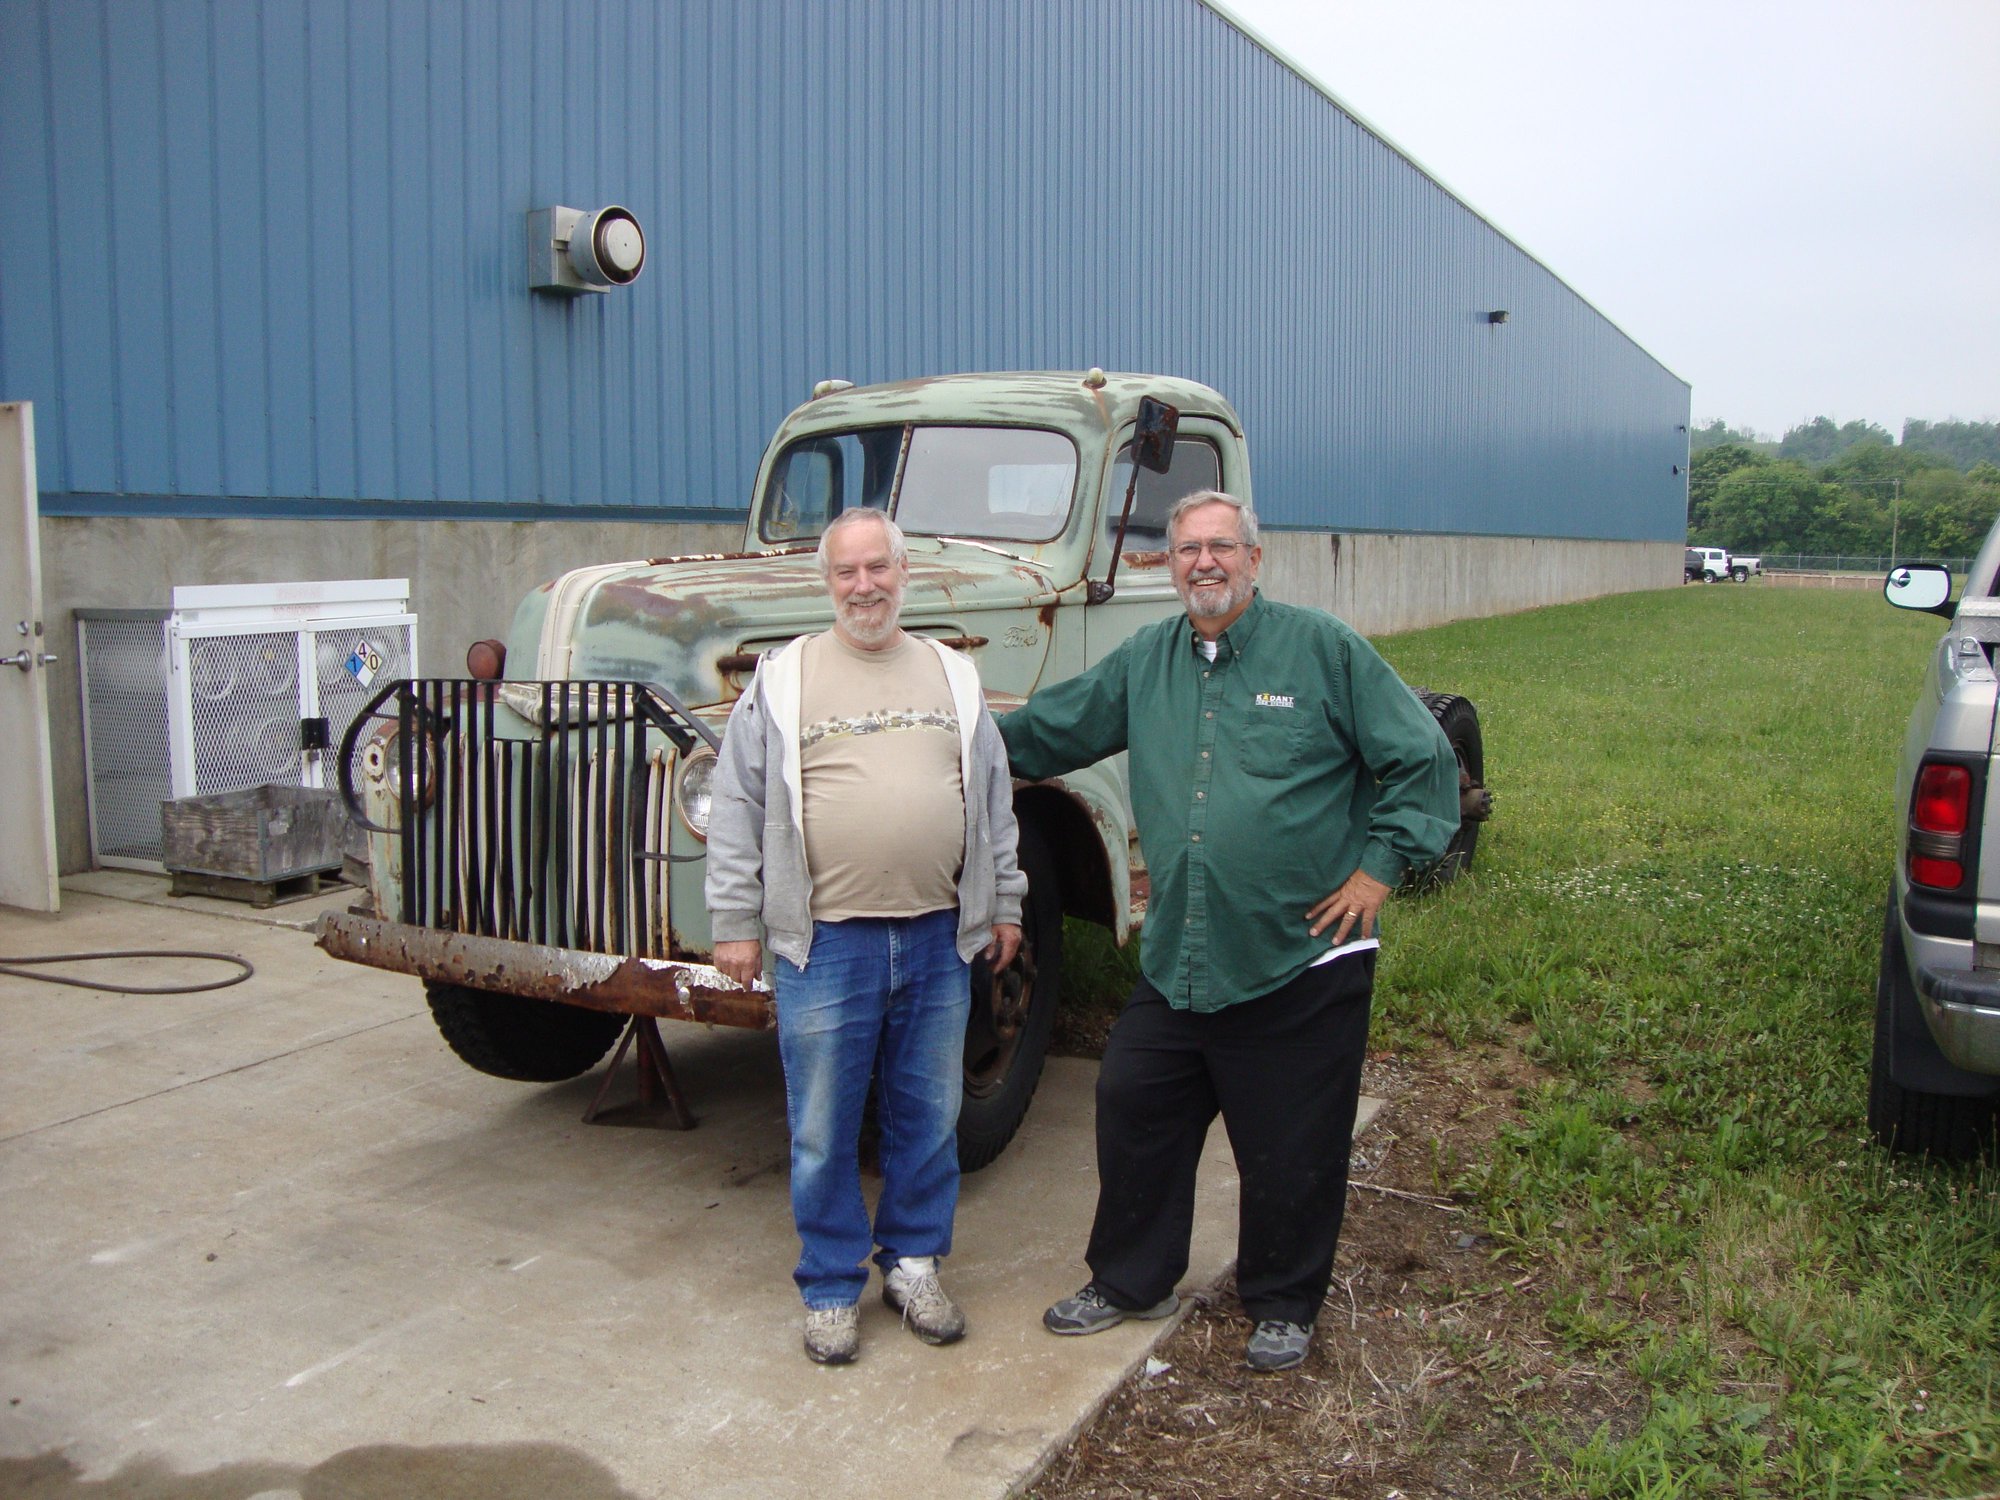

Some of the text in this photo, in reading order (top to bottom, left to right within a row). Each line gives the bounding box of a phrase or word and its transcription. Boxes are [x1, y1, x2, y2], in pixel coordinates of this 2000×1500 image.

[1002, 625, 1038, 648] Ford
[358, 642, 367, 658] 4
[350, 656, 357, 672] 1
[369, 654, 379, 670] 0
[1256, 693, 1294, 703] KADANT
